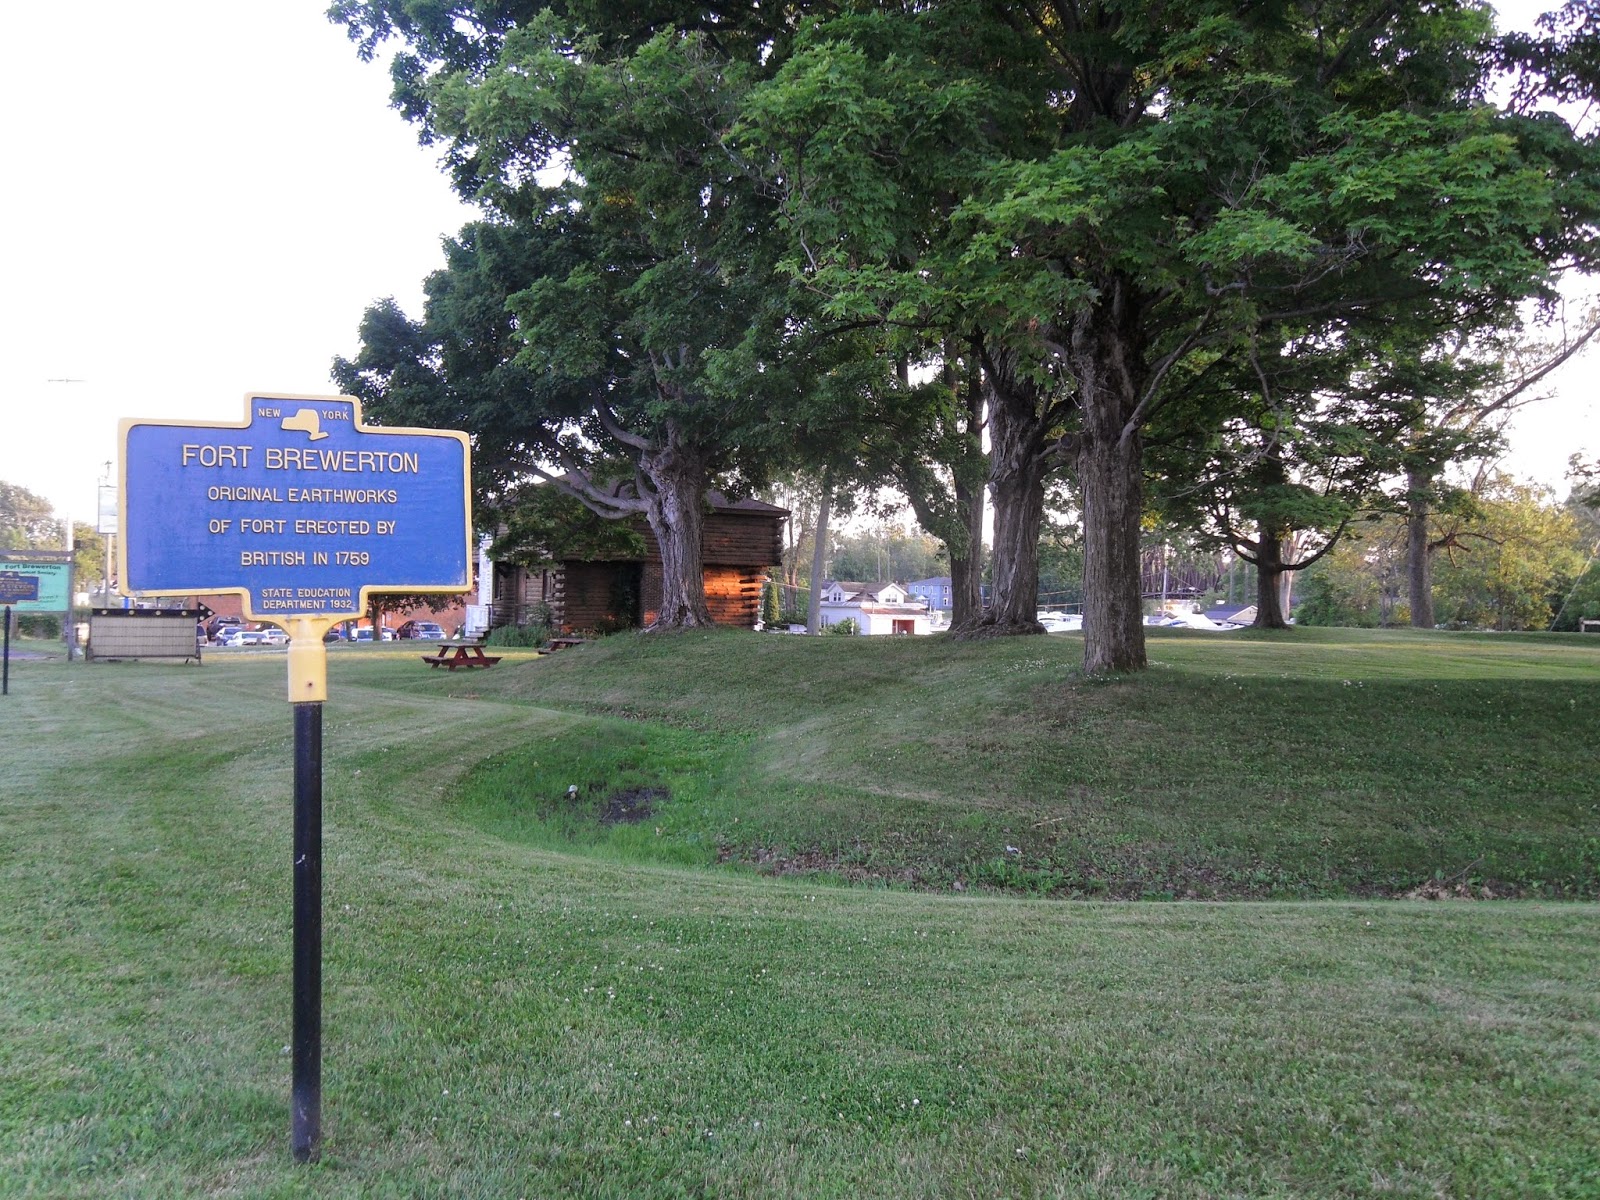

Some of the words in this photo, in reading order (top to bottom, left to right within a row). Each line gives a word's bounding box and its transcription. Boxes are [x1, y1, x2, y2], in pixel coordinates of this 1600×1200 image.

[258, 408, 281, 418] NEW
[321, 409, 349, 421] YORK
[182, 444, 252, 468] FORT
[266, 449, 418, 474] BREWERTON
[207, 486, 283, 502] ORIGINAL
[288, 488, 397, 503] EARTHWORKS
[208, 520, 231, 534] OF
[240, 520, 286, 534] FORT
[295, 520, 369, 535] ERECTED
[377, 521, 396, 535] BY
[241, 551, 305, 566] BRITISH
[313, 552, 328, 565] IN
[335, 552, 369, 566] 1759
[262, 588, 293, 598] STATE
[297, 588, 351, 598] EDUCATION
[263, 600, 326, 609] DEPARTMENT
[330, 600, 352, 608] 1932
